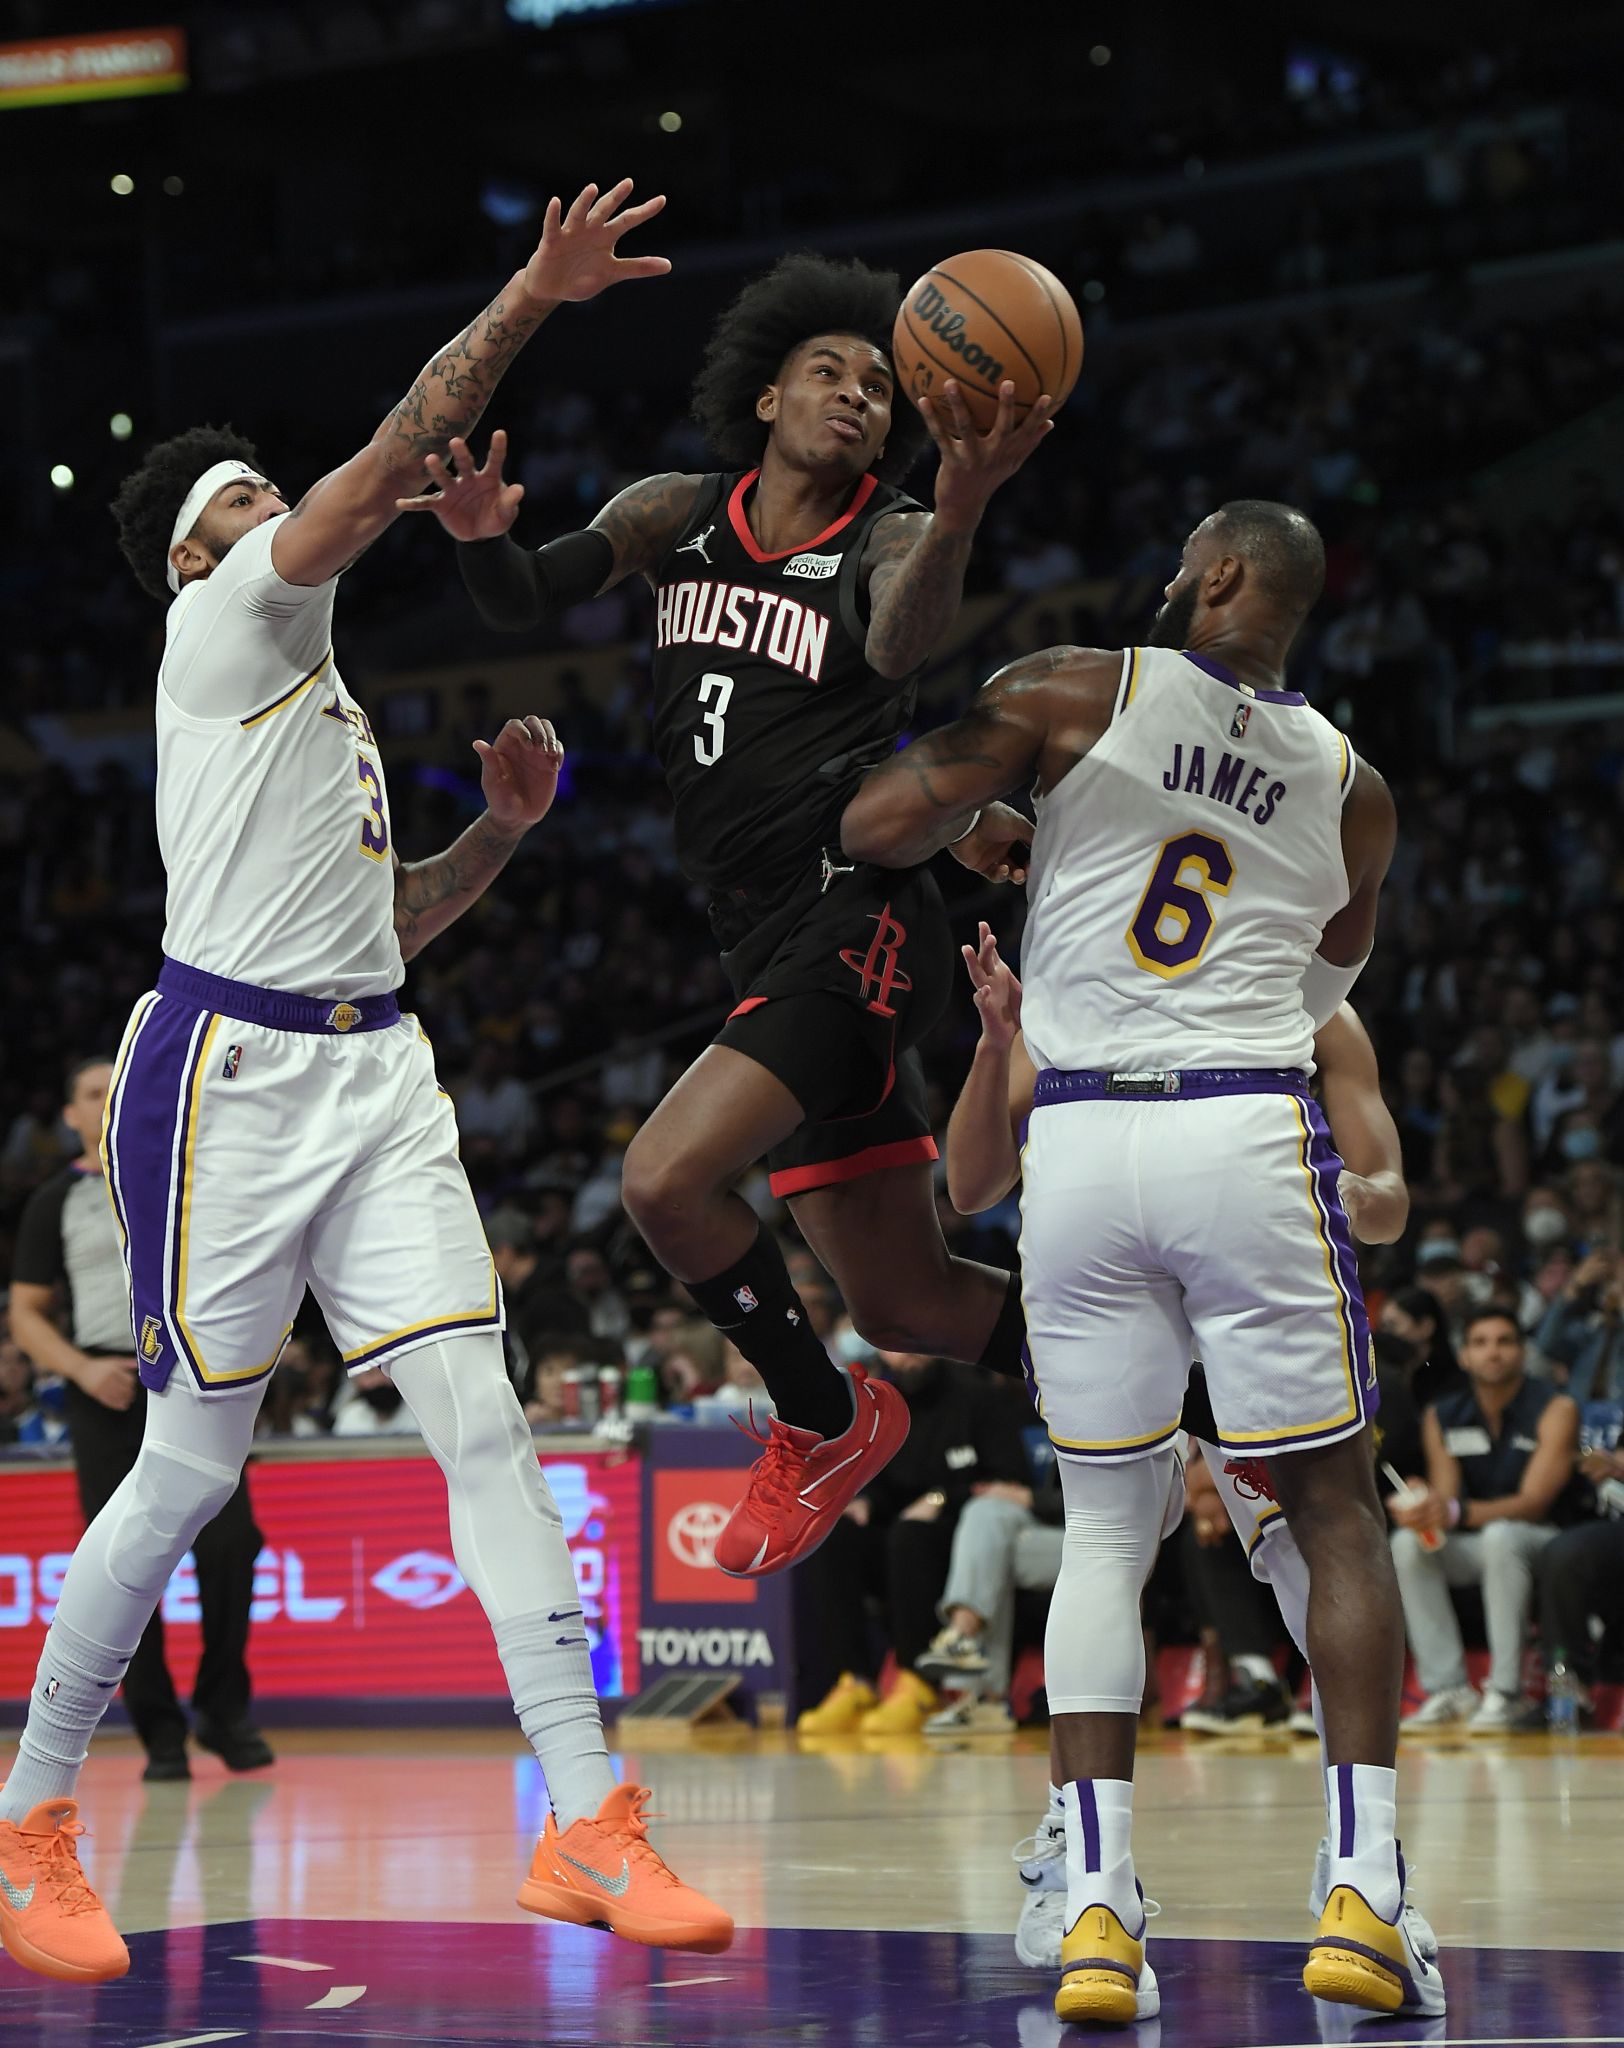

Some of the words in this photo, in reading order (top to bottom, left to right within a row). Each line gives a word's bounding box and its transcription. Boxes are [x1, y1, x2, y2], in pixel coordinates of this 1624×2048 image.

[912, 282, 1004, 385] Wilson
[785, 563, 838, 577] MONEY
[656, 580, 832, 684] HOUSTON
[693, 672, 735, 767] 3
[356, 752, 390, 864] 3
[1163, 743, 1286, 826] JAMES
[1124, 828, 1238, 981] 6
[637, 1627, 775, 1668] TOYOTA
